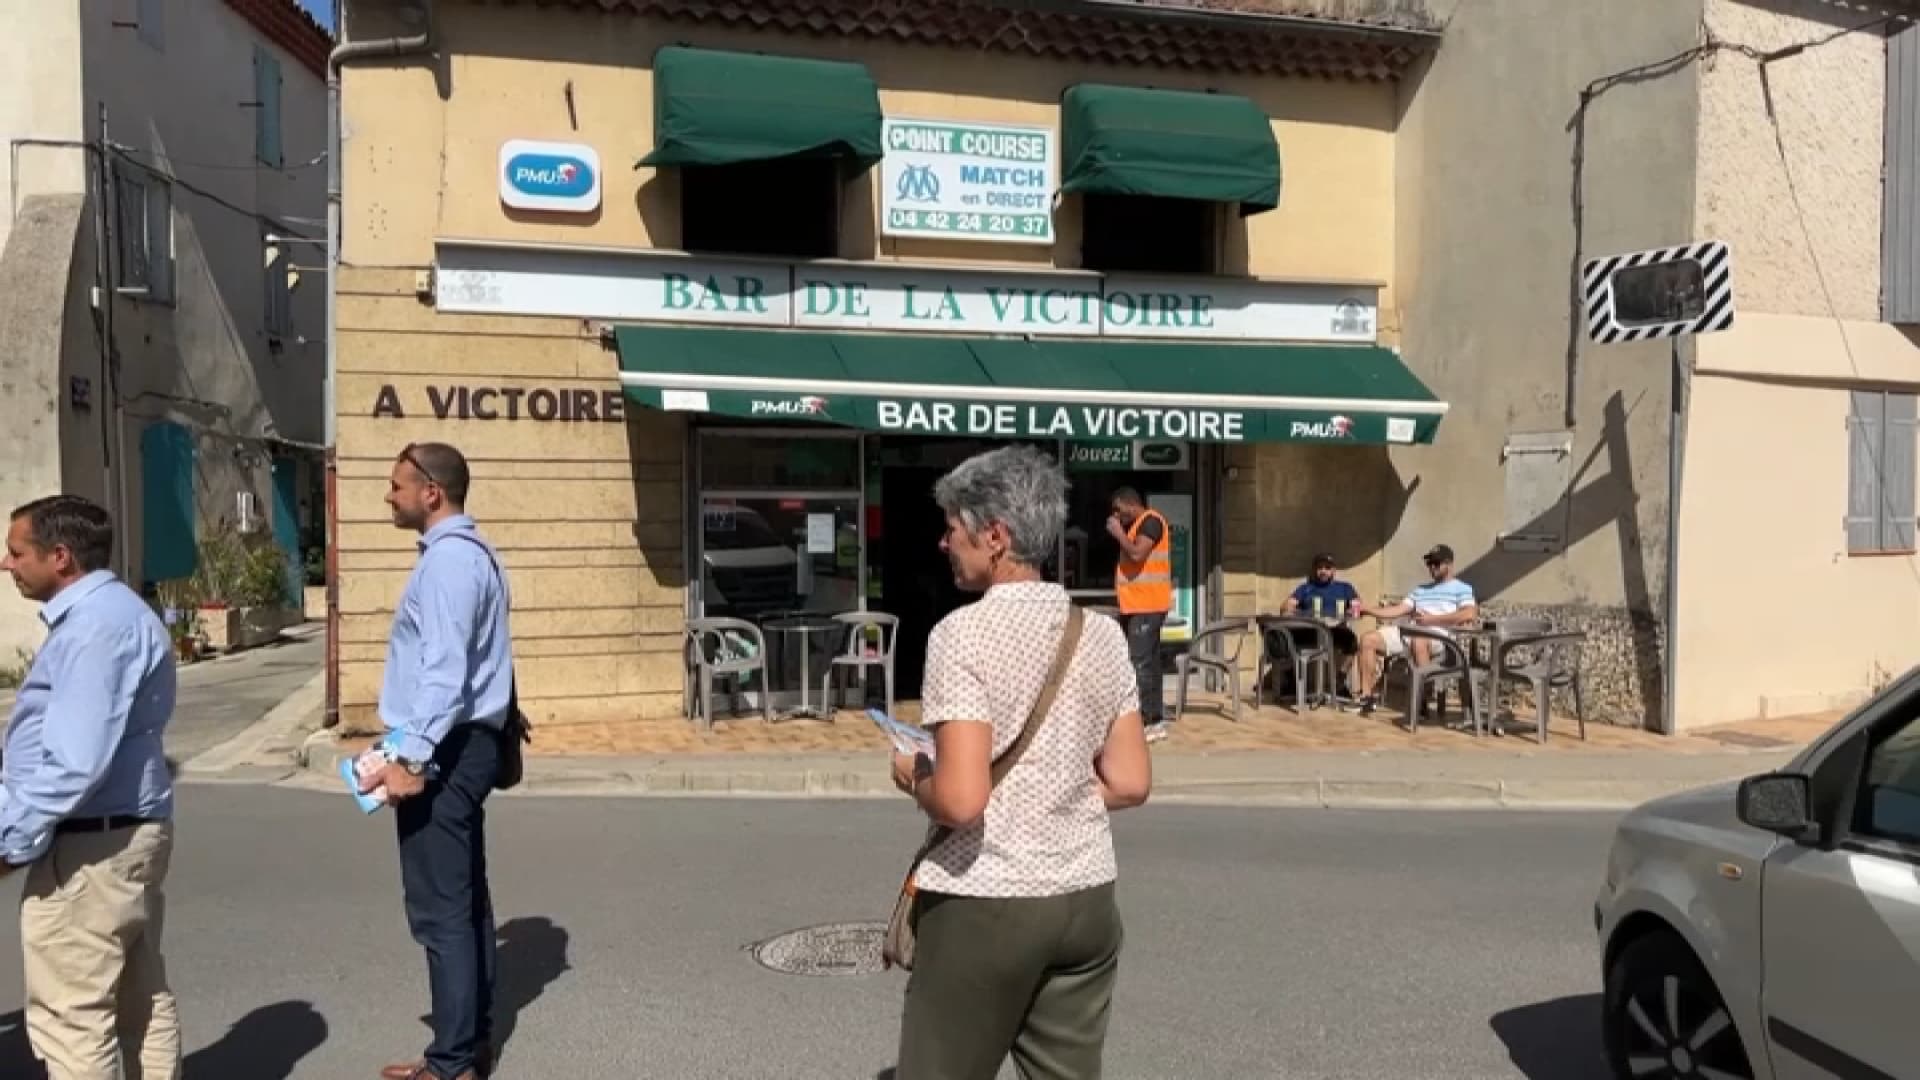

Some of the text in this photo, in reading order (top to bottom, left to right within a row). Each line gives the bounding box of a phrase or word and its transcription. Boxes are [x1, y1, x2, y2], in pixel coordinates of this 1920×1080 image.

[890, 126, 1046, 161] POINT COURSE
[515, 167, 557, 185] PMU
[959, 164, 1045, 188] MATCH
[959, 191, 1046, 209] en DIRECT
[892, 210, 1045, 234] 04 42 24 20 37
[660, 271, 1215, 328] BAR DE LA VICTOIRE
[426, 385, 625, 422] VICTOIRE
[751, 400, 801, 414] PMU
[876, 400, 1244, 440] BAR DE LA VICTOIRE
[1290, 421, 1331, 438] PMU
